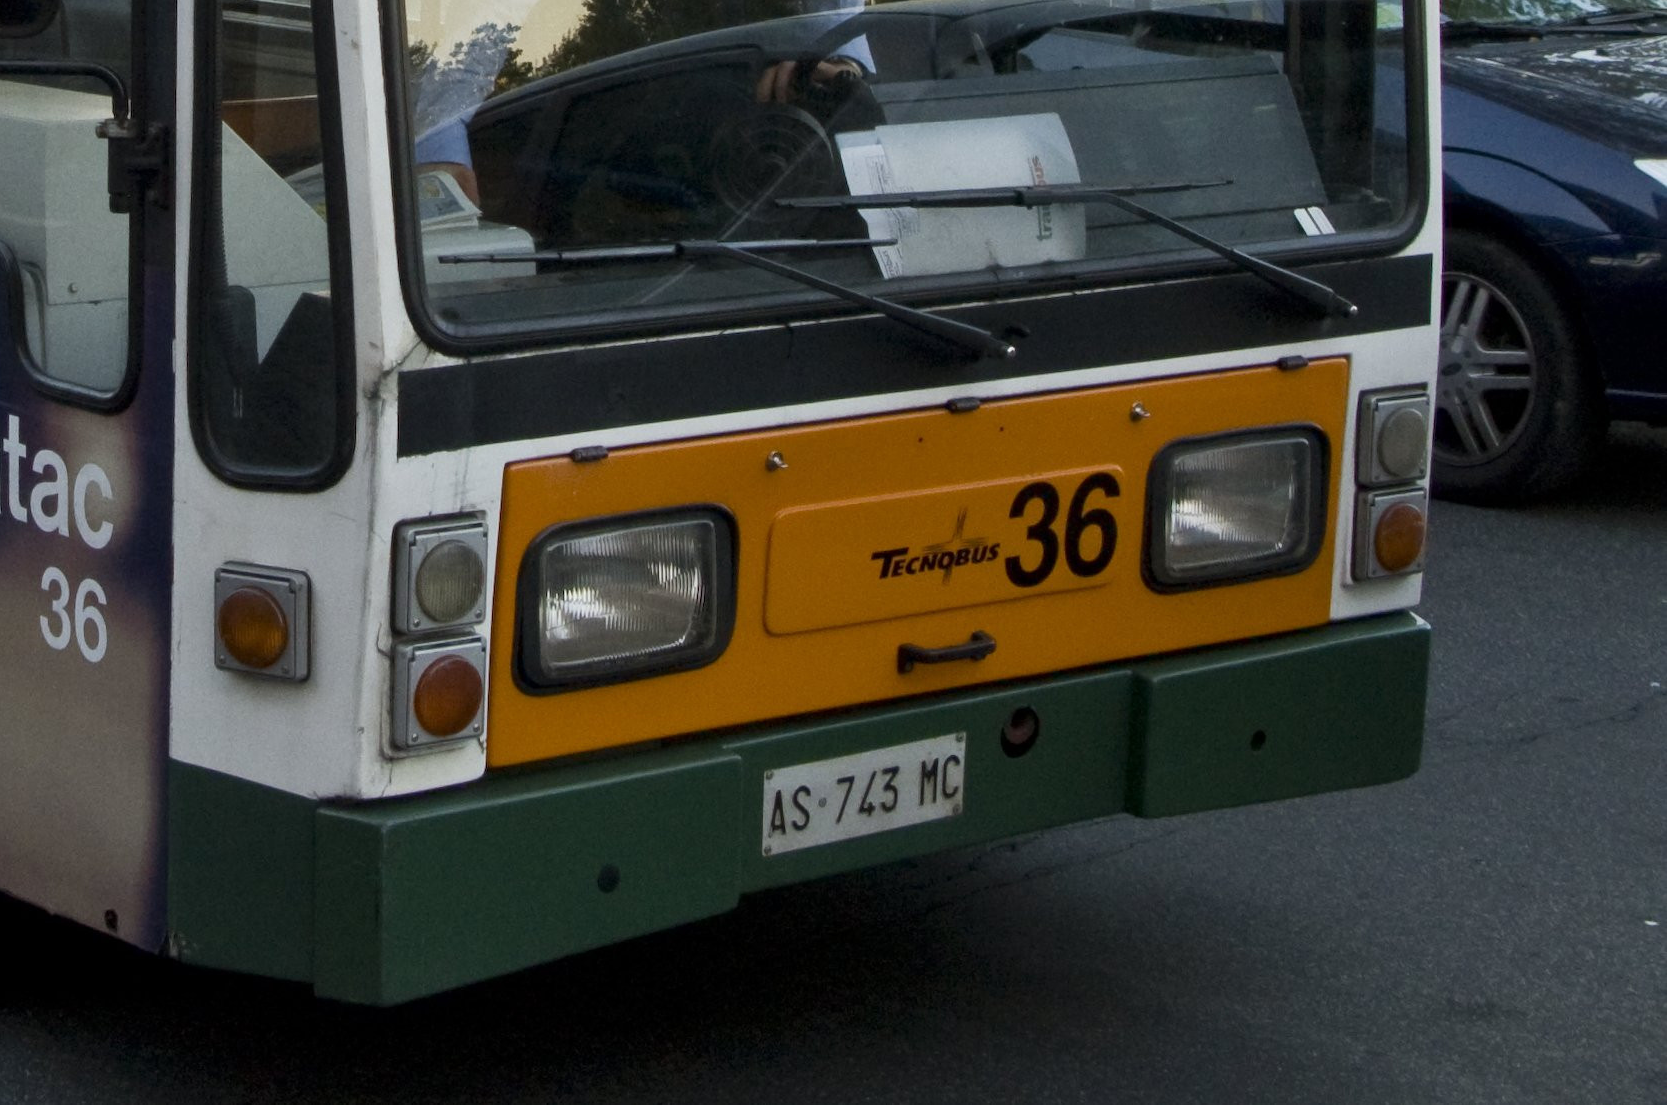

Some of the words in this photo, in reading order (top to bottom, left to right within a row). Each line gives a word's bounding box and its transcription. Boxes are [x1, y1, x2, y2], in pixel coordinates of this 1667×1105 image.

[1004, 472, 1120, 587] 36
[40, 566, 108, 663] 36
[769, 784, 812, 836] AS
[835, 765, 901, 825] 743
[919, 754, 961, 807] MC
